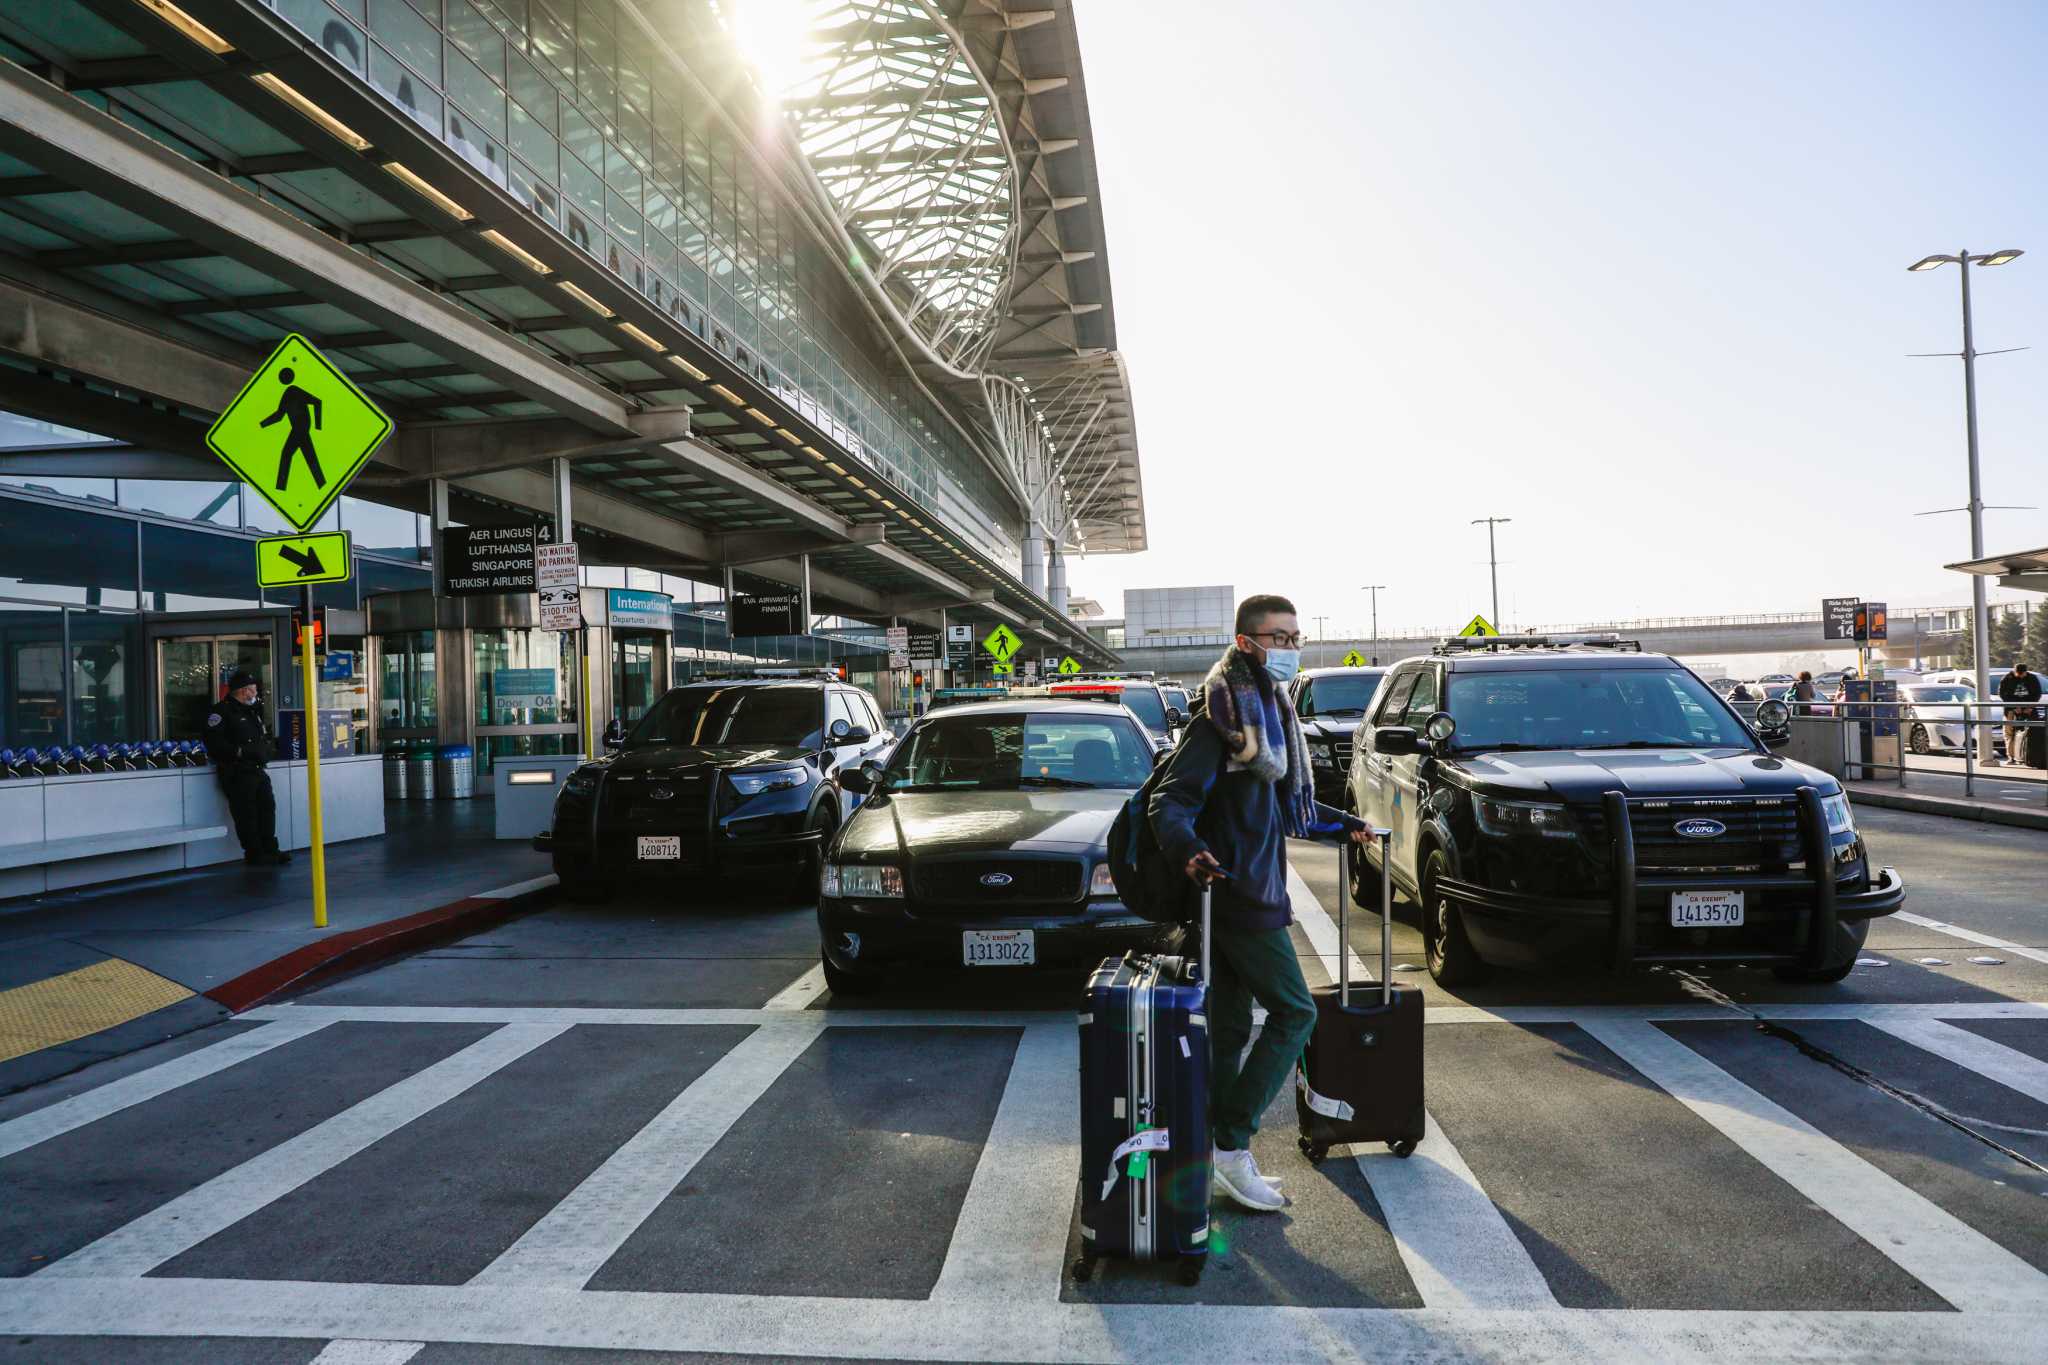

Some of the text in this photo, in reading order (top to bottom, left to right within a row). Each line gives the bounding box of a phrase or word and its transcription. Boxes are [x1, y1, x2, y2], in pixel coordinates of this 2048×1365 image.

[469, 527, 533, 540] AER LINGUS
[538, 525, 550, 541] 4
[469, 543, 533, 556] LUFTHANSA
[539, 546, 575, 557] NO WAITING
[472, 559, 534, 571] SINGAPORE
[538, 556, 576, 567] NO PARKING
[449, 577, 489, 588] TURKISH
[492, 575, 534, 586] AIRLINES
[758, 596, 788, 604] AIRWAYS
[791, 594, 800, 605] 4
[562, 605, 578, 614] FINE
[761, 605, 789, 613] FINNAIR
[1838, 625, 1854, 637] 14
[497, 695, 554, 708] Door 04
[640, 845, 677, 856] 1608712
[1676, 904, 1739, 922] 1413570
[968, 942, 1030, 960] 1313022
